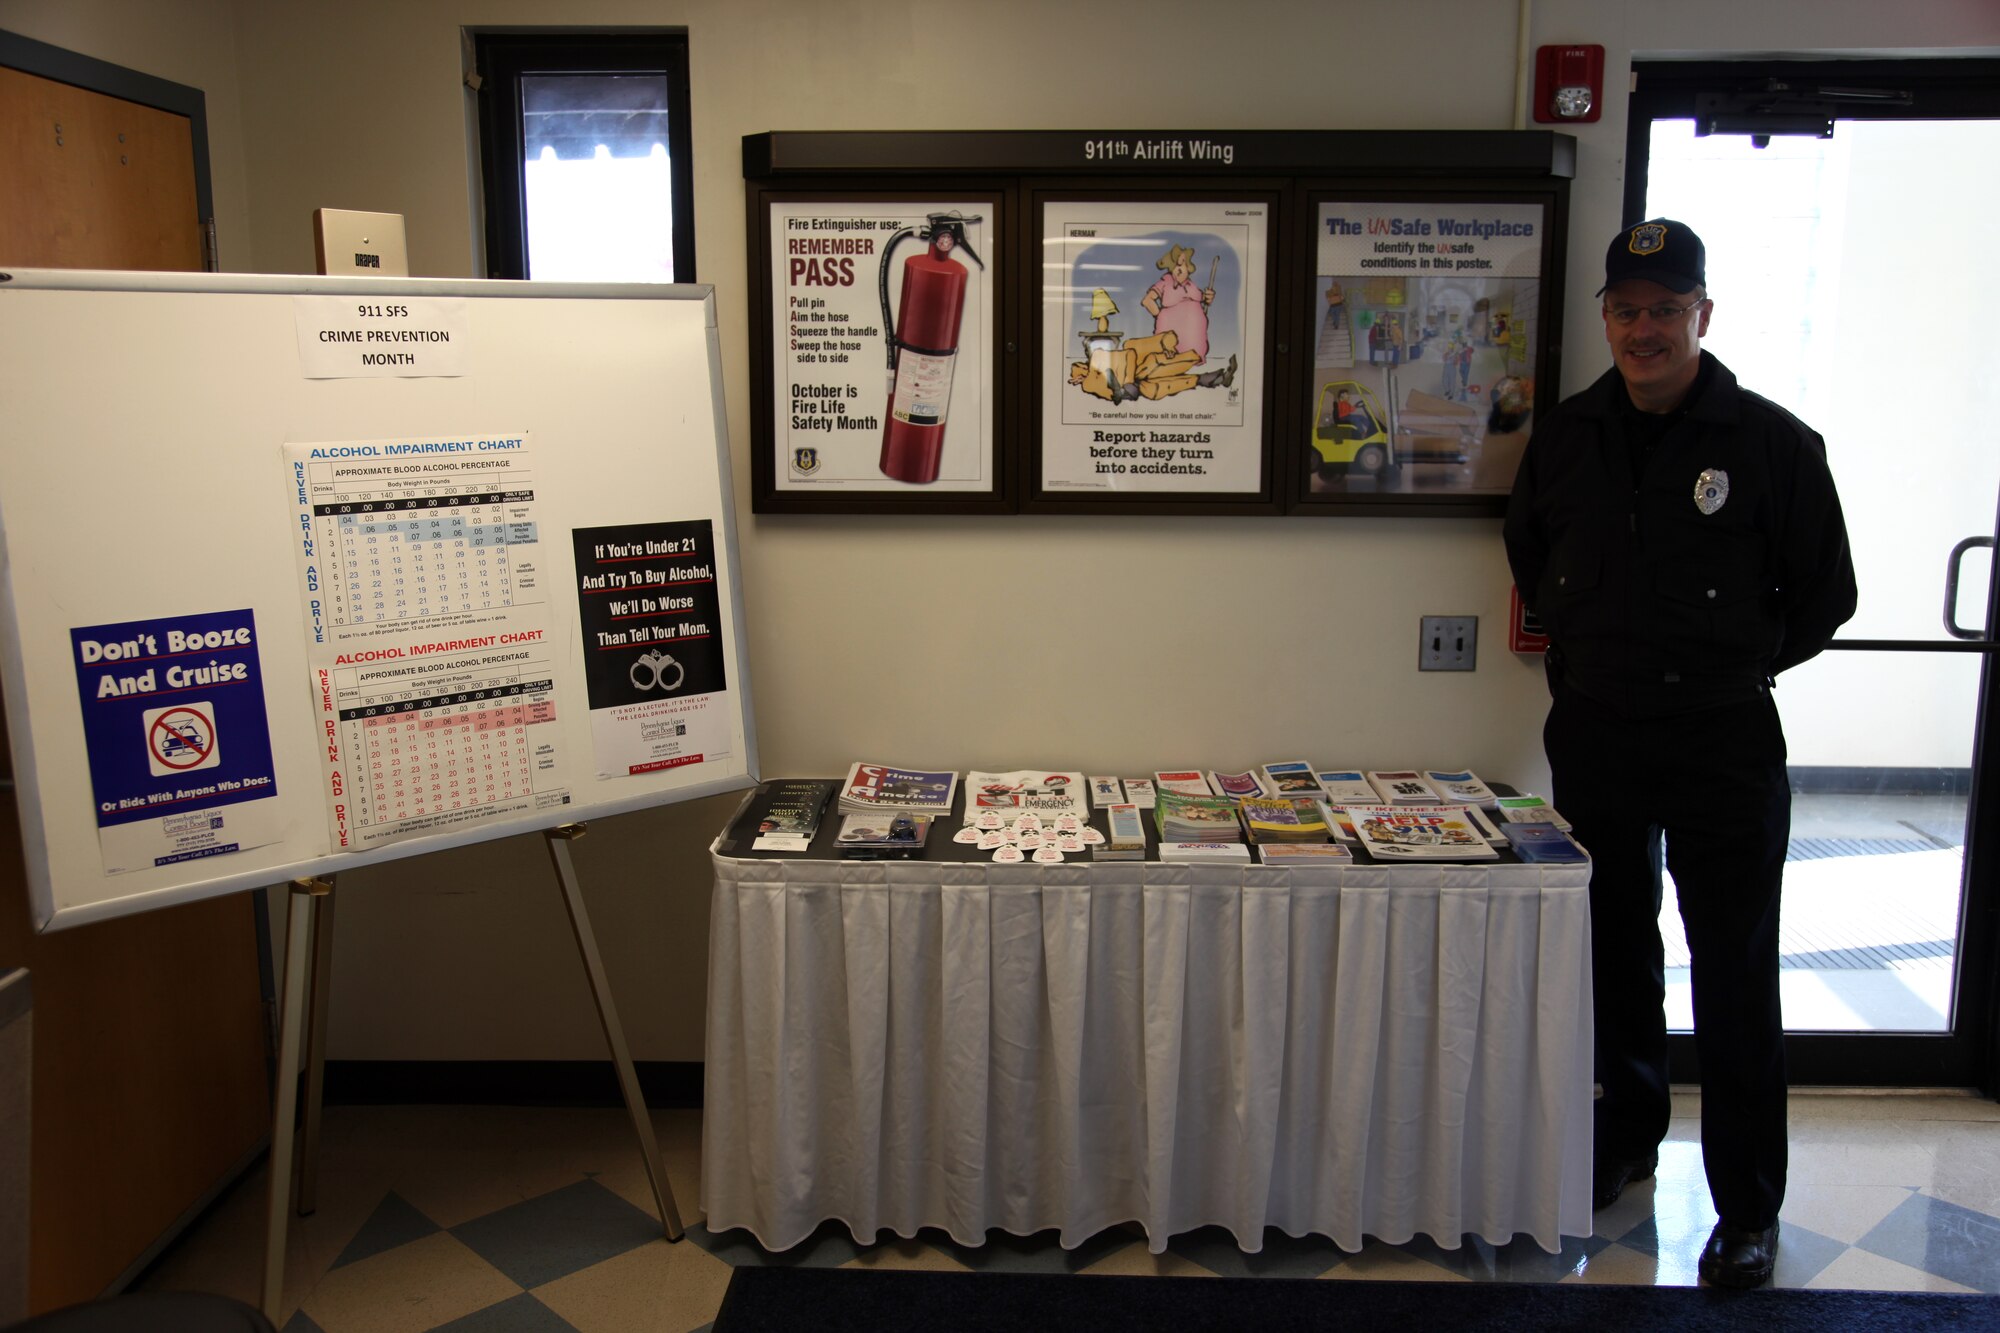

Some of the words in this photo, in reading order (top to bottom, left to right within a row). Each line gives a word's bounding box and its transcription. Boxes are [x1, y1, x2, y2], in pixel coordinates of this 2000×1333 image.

[1085, 140, 1128, 160] 911th
[1133, 140, 1183, 159] Airlift
[1189, 140, 1234, 164] Wing
[788, 219, 809, 230] Fire
[812, 219, 877, 232] Extinguisher
[880, 220, 902, 230] use:
[1070, 229, 1096, 238] HERMAN
[1326, 218, 1362, 235] The
[1437, 219, 1533, 241] Workplace
[788, 238, 875, 255] REMEMBER
[1374, 241, 1414, 255] Identify
[1418, 242, 1435, 253] the
[790, 257, 855, 287] PASS
[1360, 257, 1417, 269] conditions
[1420, 257, 1430, 269] in
[1433, 257, 1453, 269] this
[1456, 259, 1493, 271] poster.
[358, 305, 383, 317] 911
[386, 305, 408, 317] SFS
[790, 296, 808, 308] Pull
[811, 297, 825, 309] pin
[790, 310, 808, 322] Aim
[811, 311, 825, 322] the
[828, 311, 849, 322] hose
[319, 330, 363, 342] CRIME
[367, 330, 450, 342] PREVENTION
[790, 324, 828, 338] Squeeze
[830, 326, 845, 336] the
[847, 326, 878, 337] handle
[790, 339, 821, 353] Sweep
[823, 340, 838, 351] the
[840, 340, 861, 351] hose
[362, 353, 415, 365] MONTH
[797, 352, 816, 363] side
[818, 353, 828, 363] to
[829, 352, 849, 363] side
[791, 383, 842, 398] October
[846, 384, 858, 398] is
[792, 399, 817, 414] Fire
[821, 399, 845, 414] Life
[1103, 411, 1128, 419] careful
[792, 415, 833, 433] Safety
[837, 415, 878, 430] Month
[1093, 430, 1146, 444] Report
[1149, 431, 1211, 443] hazards
[310, 446, 381, 459] ALCOHOL
[384, 441, 474, 455] IMPAIRMENT
[478, 439, 523, 450] CHART
[1089, 446, 1137, 458] before
[1141, 447, 1176, 461] they
[1179, 448, 1214, 459] turn
[335, 466, 392, 477] APPROXIMATE
[394, 465, 421, 474] BLOOD
[423, 462, 459, 472] ALCOHOL
[461, 460, 511, 470] PERCENTAGE
[1095, 461, 1126, 474] into
[1130, 462, 1207, 474] accidents.
[294, 461, 308, 505] NEVER
[300, 514, 315, 557] DRINK
[595, 545, 604, 559] If
[607, 542, 643, 558] You're
[645, 539, 679, 555] Under
[682, 537, 696, 551] 21
[306, 565, 319, 592] AND
[582, 574, 605, 589] And
[608, 573, 627, 588] Try
[629, 571, 642, 585] To
[645, 570, 666, 585] Buy
[669, 564, 713, 581] Alcohol,
[609, 600, 639, 616] We'll
[641, 599, 656, 612] Do
[658, 596, 694, 610] Worse
[310, 600, 324, 643] DRIVE
[597, 631, 627, 646] Than
[629, 628, 649, 642] Tell
[651, 626, 676, 640] Your
[679, 622, 710, 637] Mom.
[80, 633, 158, 664] Don't
[167, 627, 251, 653] Booze
[335, 648, 406, 665] ALCOHOL
[409, 636, 496, 656] IMPAIRMENT
[500, 630, 543, 644] CHART
[360, 667, 417, 681] APPROXIMATE
[418, 663, 445, 674] BLOOD
[446, 659, 481, 669] ALCOHOL
[482, 651, 530, 664] PERCENTAGE
[97, 669, 156, 698] And
[166, 659, 248, 689] Cruise
[427, 678, 446, 686] Weight
[452, 674, 472, 682] Pounds
[318, 669, 333, 712] NEVER
[651, 709, 679, 717] DRINKING
[325, 719, 339, 762] DRINK
[331, 771, 343, 797] AND
[851, 785, 938, 799] America
[101, 801, 117, 812] Or
[119, 796, 146, 809] Ride
[147, 791, 173, 804] With
[176, 786, 216, 801] Anyone
[218, 780, 241, 792] Who
[243, 776, 271, 787] Does.
[1025, 798, 1075, 808] EMERGENCY
[335, 804, 349, 846] DRIVE
[1375, 816, 1446, 826] HELP
